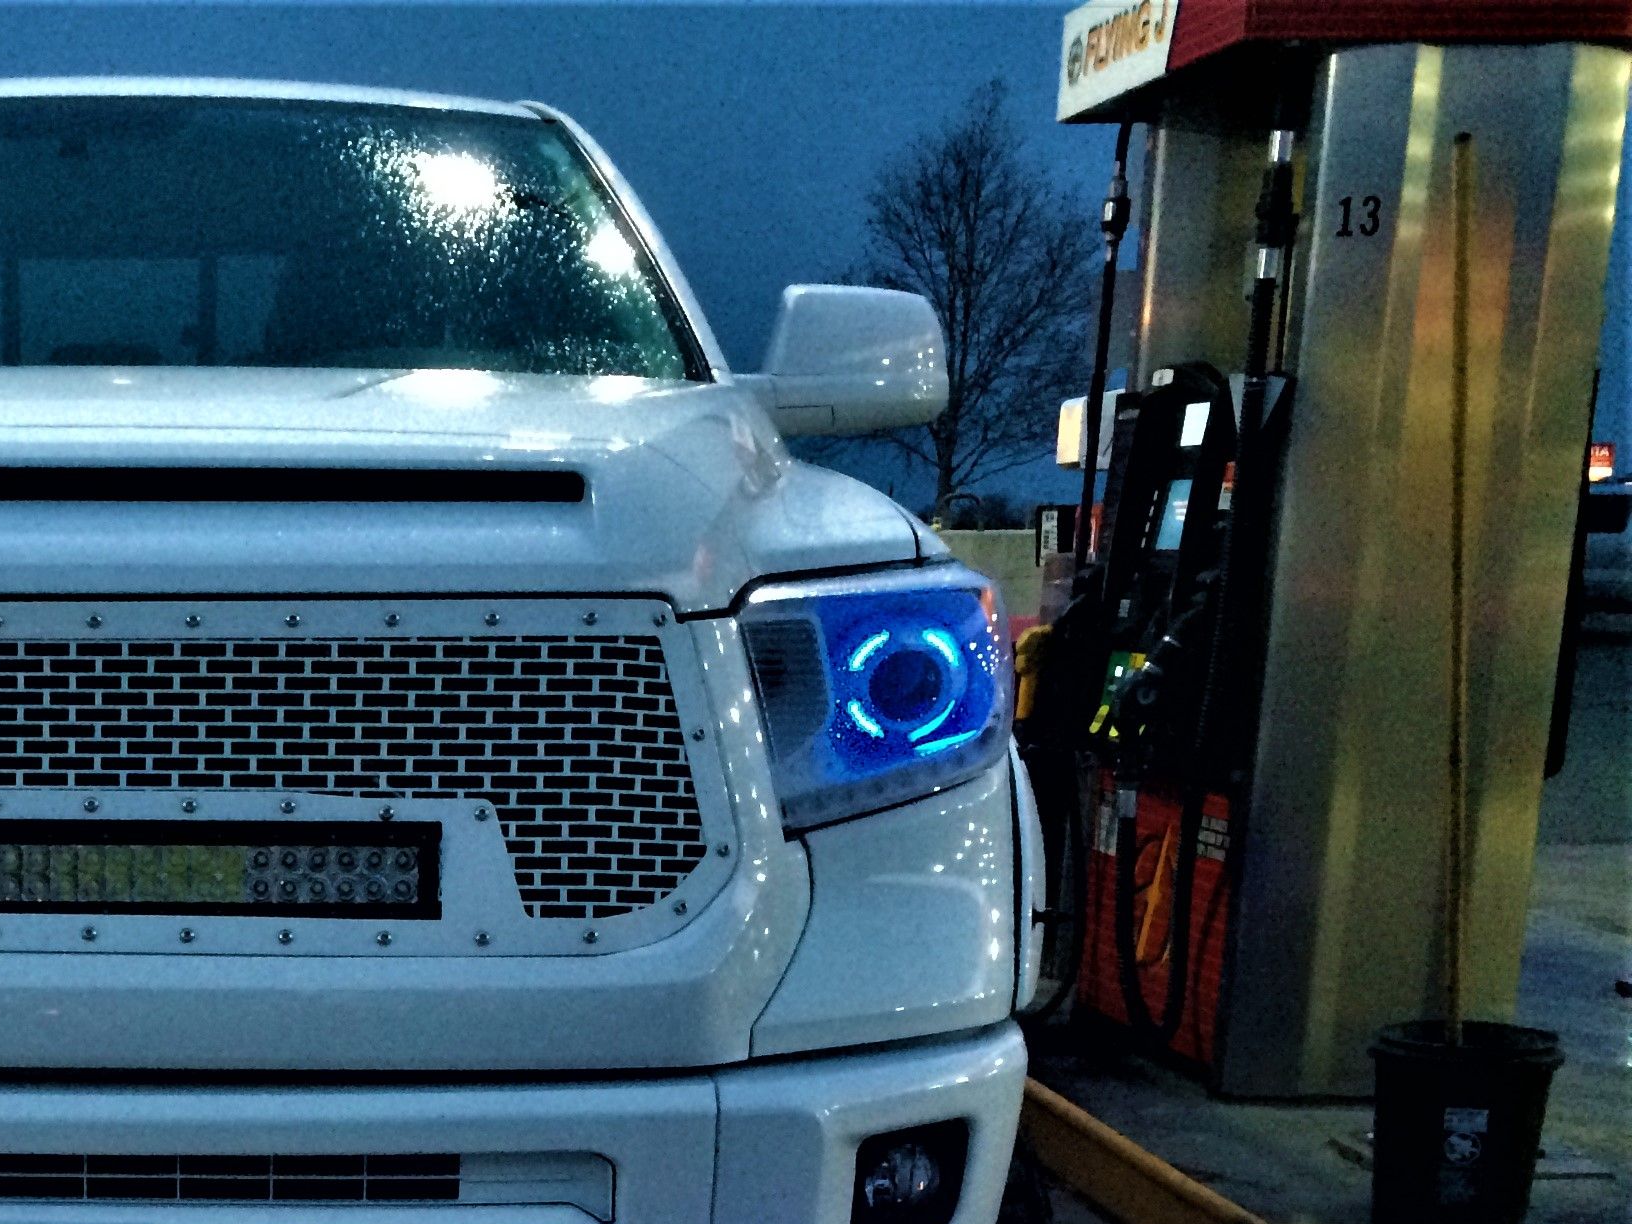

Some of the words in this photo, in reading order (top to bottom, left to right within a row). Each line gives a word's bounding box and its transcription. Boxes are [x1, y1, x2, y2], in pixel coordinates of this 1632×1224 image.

[1083, 0, 1151, 76] FLYING
[1154, 0, 1168, 43] J
[1336, 195, 1381, 237] 13
